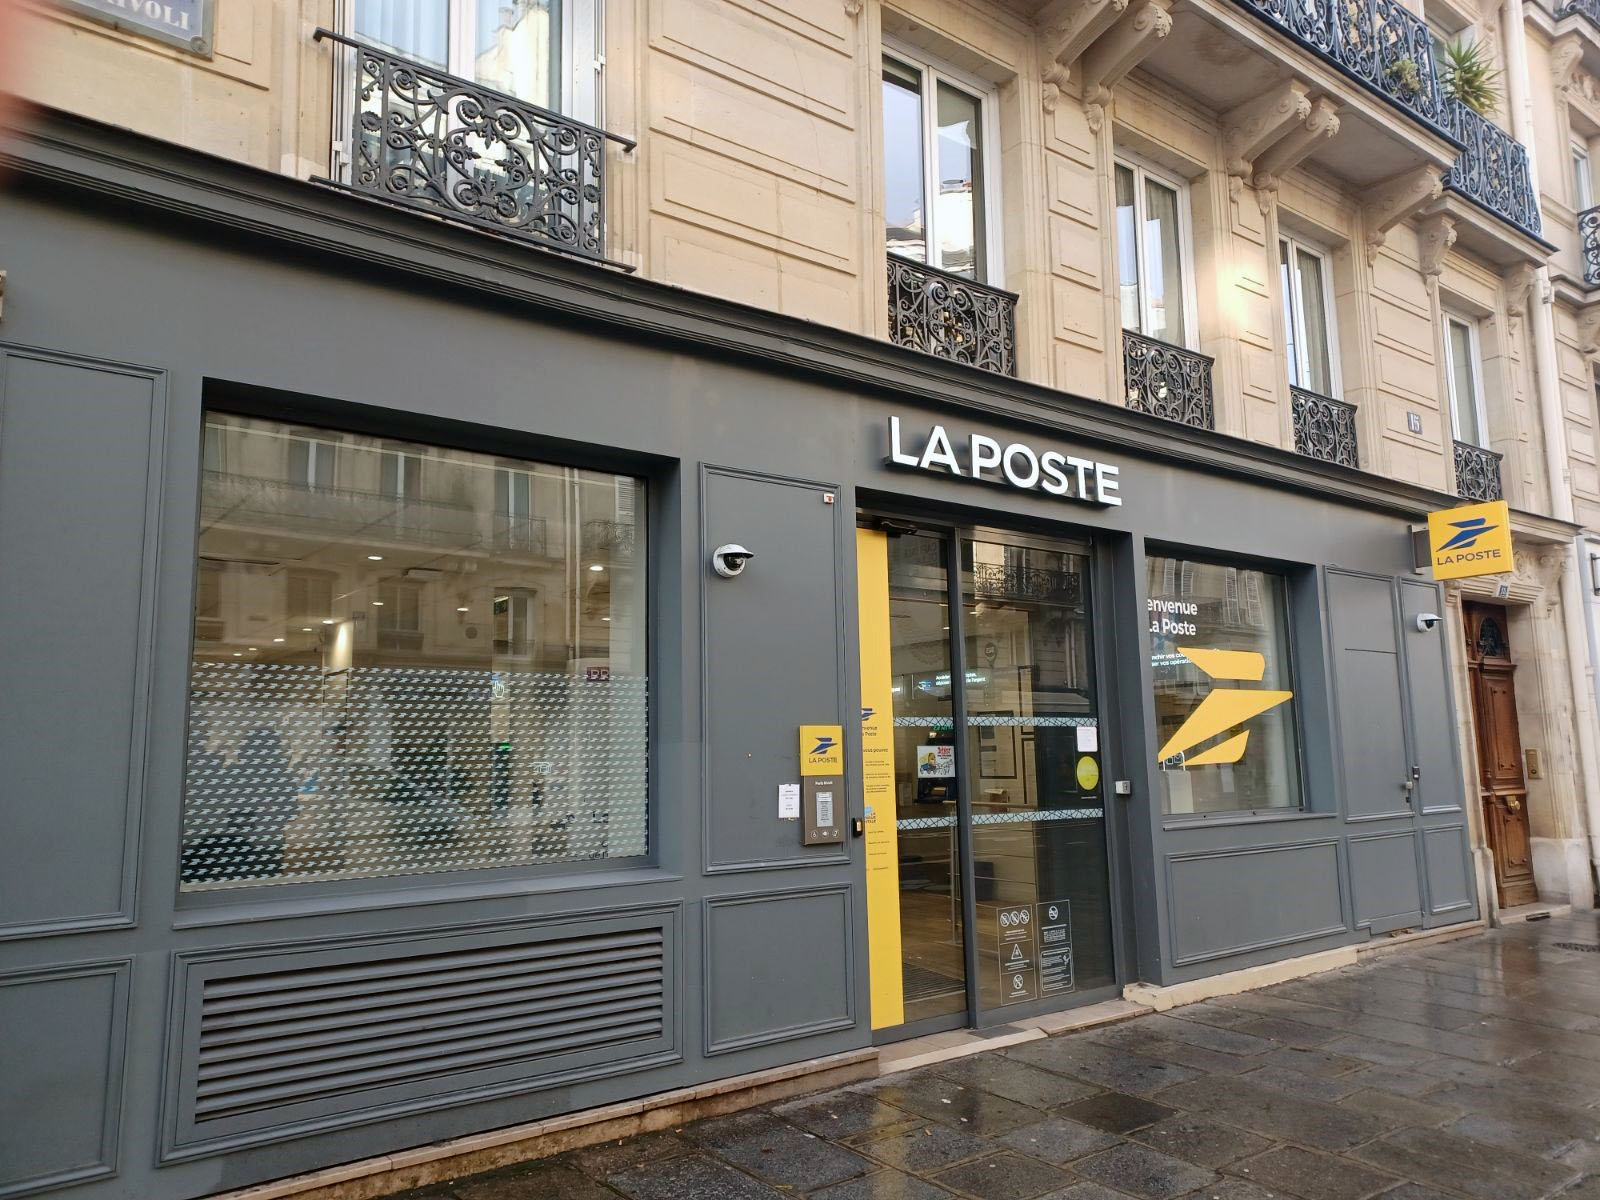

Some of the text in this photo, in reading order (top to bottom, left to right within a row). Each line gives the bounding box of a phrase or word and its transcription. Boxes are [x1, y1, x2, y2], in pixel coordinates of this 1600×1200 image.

[888, 415, 1122, 506] LA POSTE
[1437, 549, 1502, 566] LA POSTE
[1162, 618, 1197, 636] Poste
